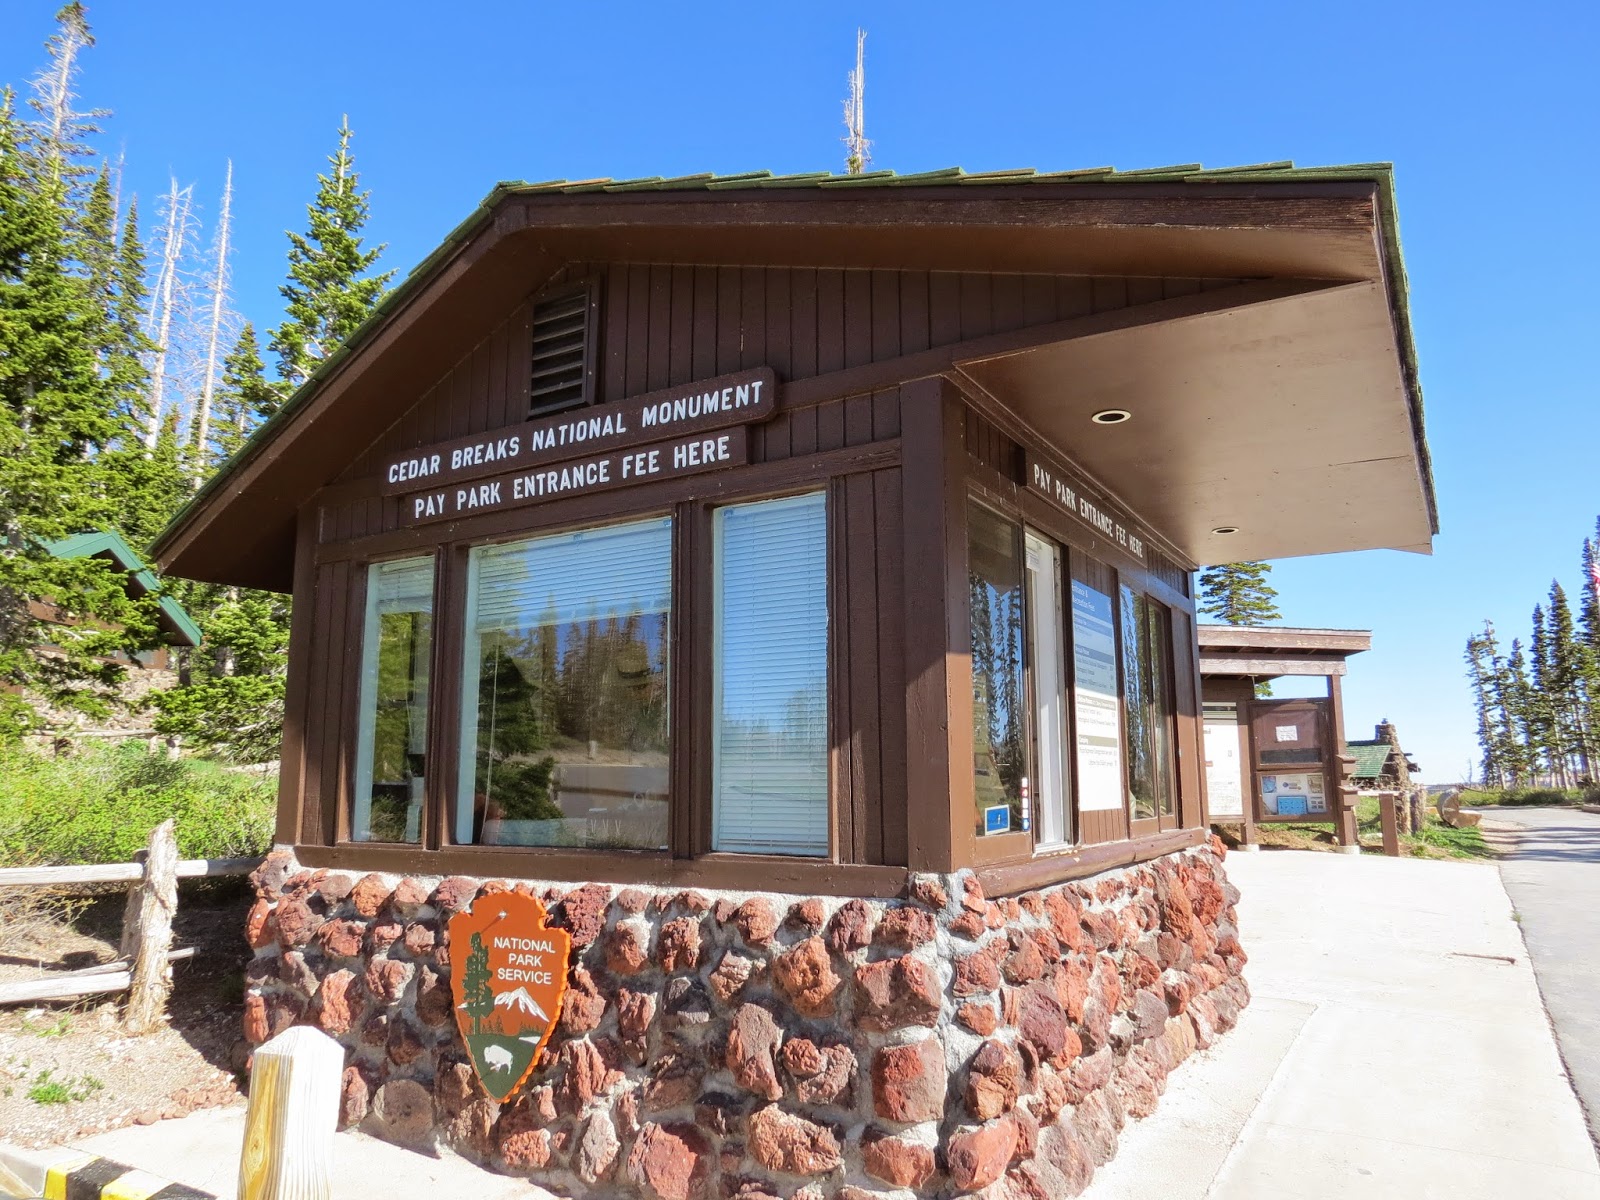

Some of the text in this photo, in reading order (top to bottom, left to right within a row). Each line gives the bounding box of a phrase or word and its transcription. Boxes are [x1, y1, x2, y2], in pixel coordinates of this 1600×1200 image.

[388, 380, 763, 484] CEDAR BREAKS NATIONAL MONUMENT
[414, 435, 731, 519] PAY PARK ENTRANCE FEE HERE
[1033, 463, 1143, 559] PAY PARK ENTRANCE FEE HERE
[493, 936, 556, 954] NATIONAL
[508, 952, 543, 968] PARK
[497, 967, 552, 985] SERVICE
